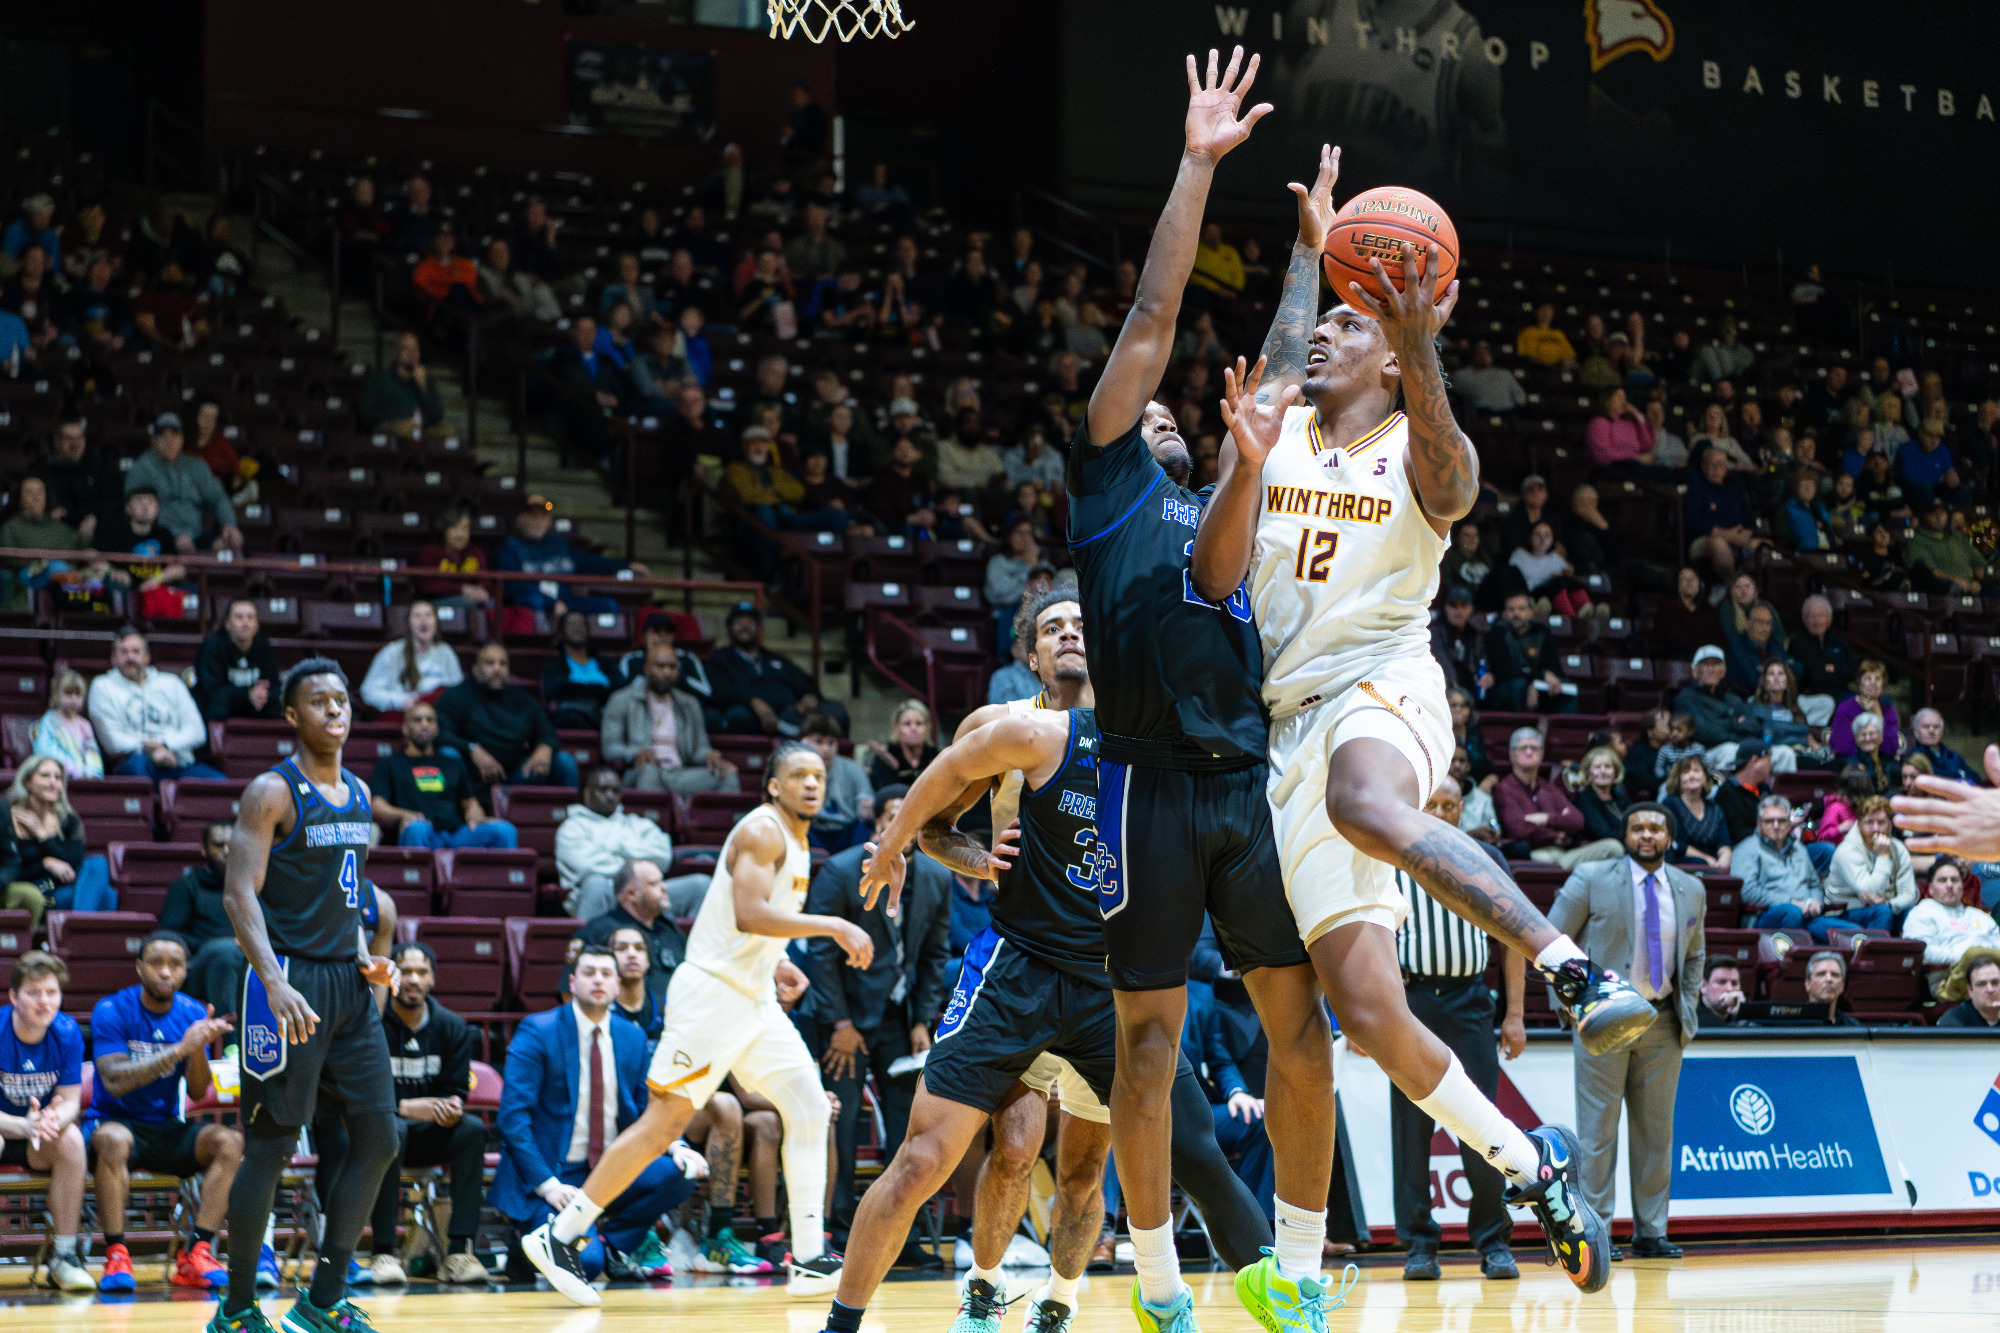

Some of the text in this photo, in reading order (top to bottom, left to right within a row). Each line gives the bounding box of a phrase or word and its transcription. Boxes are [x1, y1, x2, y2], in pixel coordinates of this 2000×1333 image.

[1215, 4, 1995, 122] WINTHROP BASKETBA
[1350, 200, 1440, 234] SPALDING
[1350, 232, 1427, 257] LEGAY
[1162, 498, 1199, 529] PRE
[1266, 484, 1392, 525] WINTHROP
[1294, 527, 1340, 583] 12
[1058, 789, 1096, 820] PRE
[338, 849, 358, 908] 4
[1680, 1142, 1853, 1172] Atrium Health
